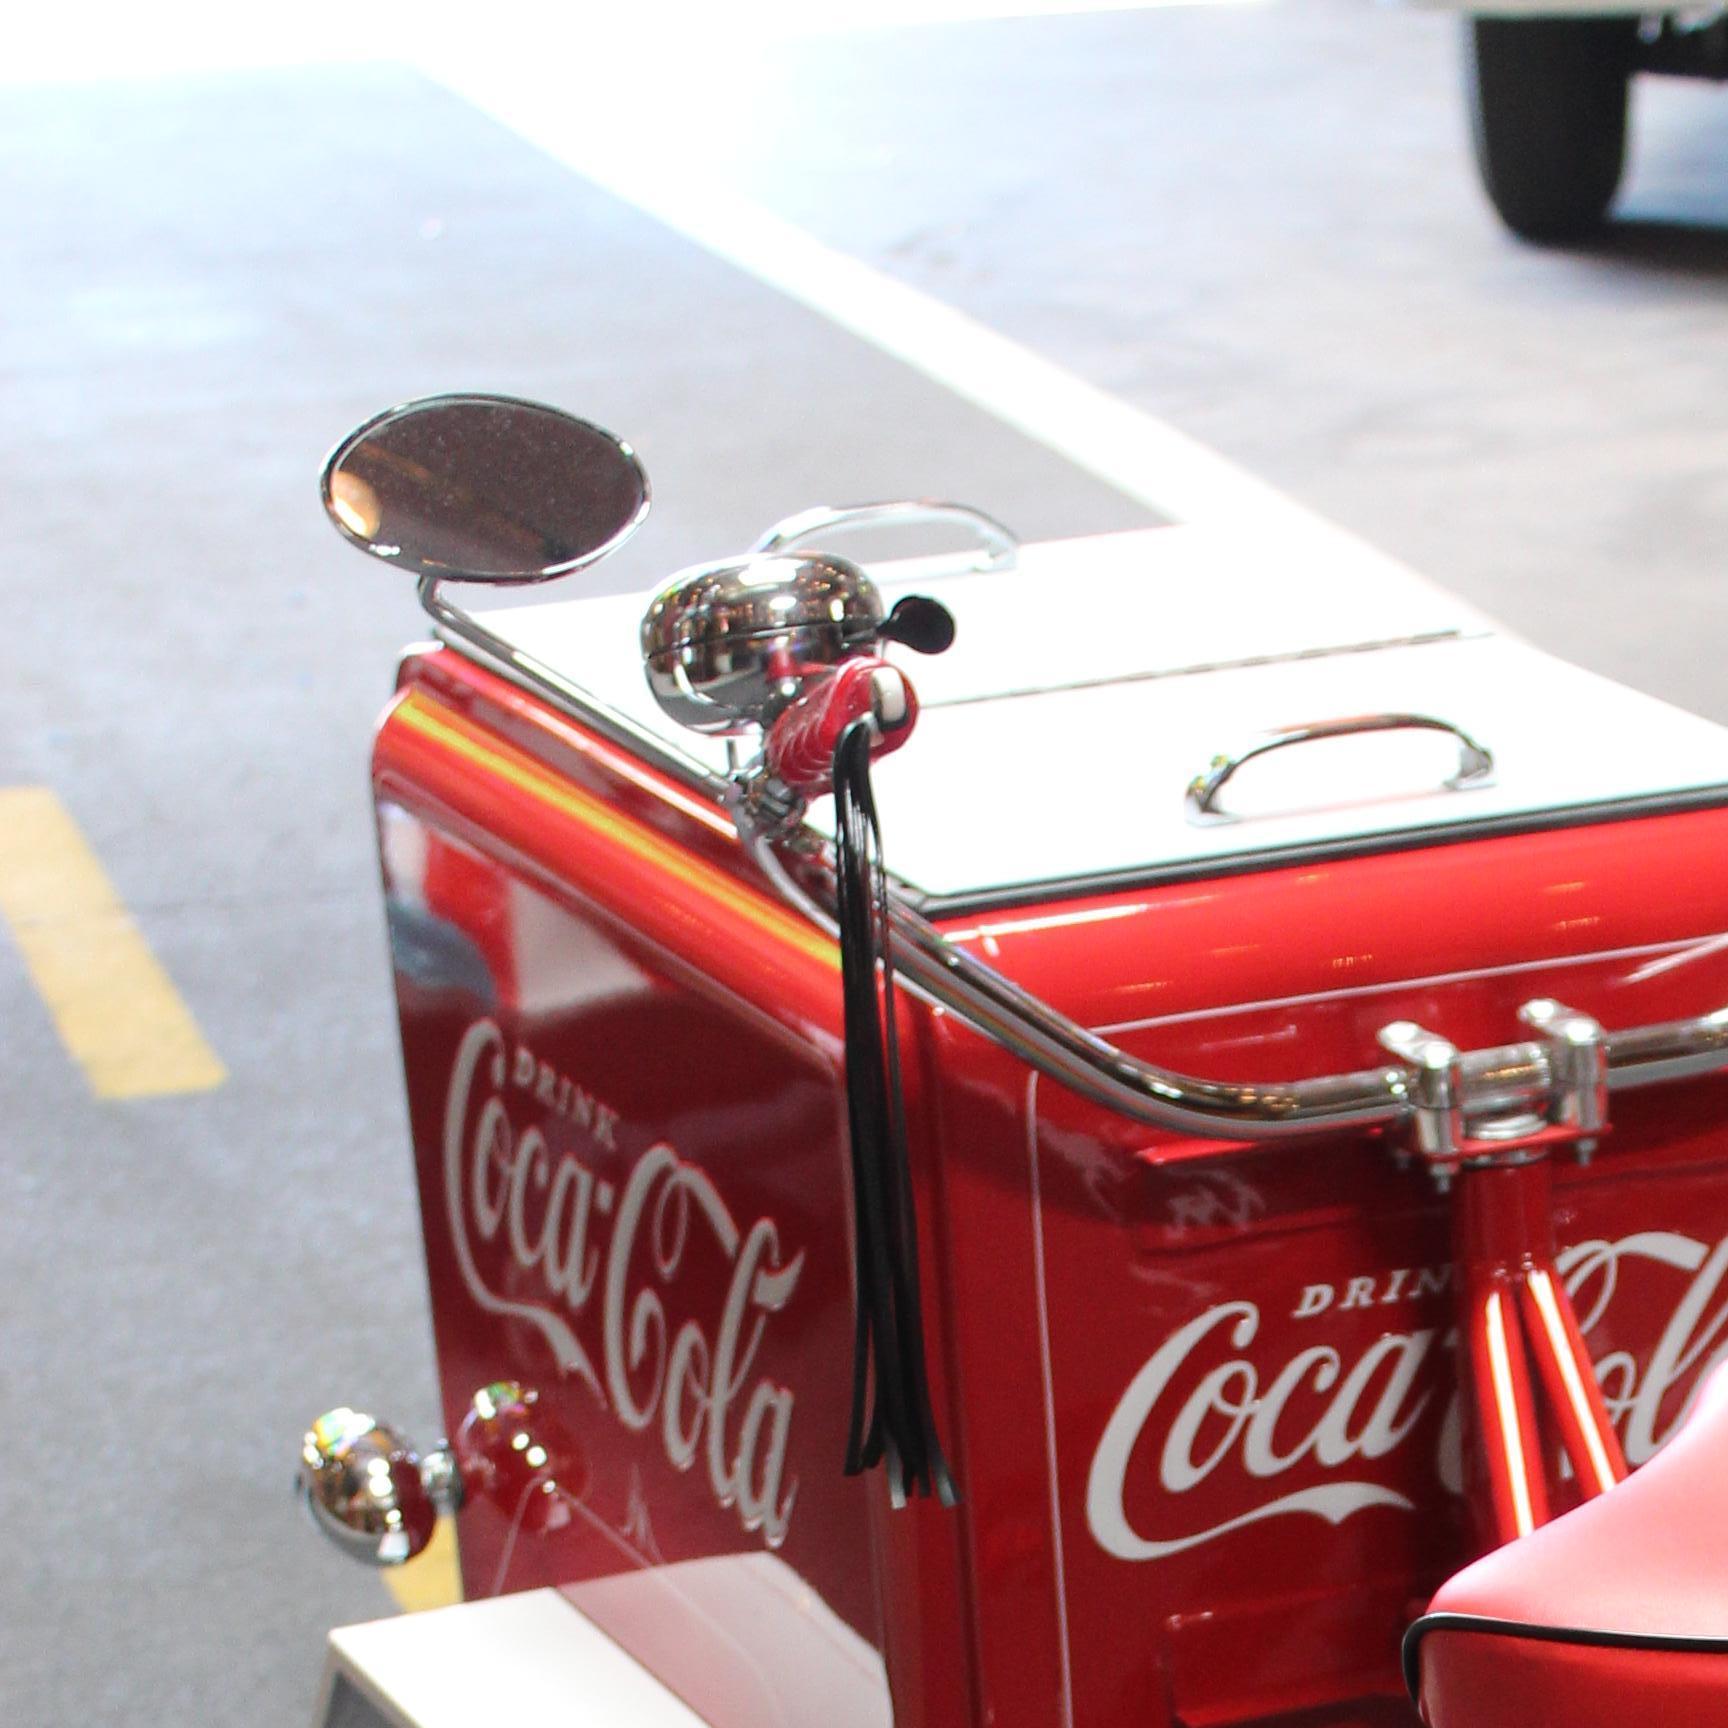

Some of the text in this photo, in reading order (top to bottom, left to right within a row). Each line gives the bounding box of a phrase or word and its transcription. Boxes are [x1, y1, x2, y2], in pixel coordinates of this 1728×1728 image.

[513, 1048, 619, 1152] DRINK
[444, 1018, 804, 1548] Coca-Cola
[1291, 1262, 1457, 1318] DRIN
